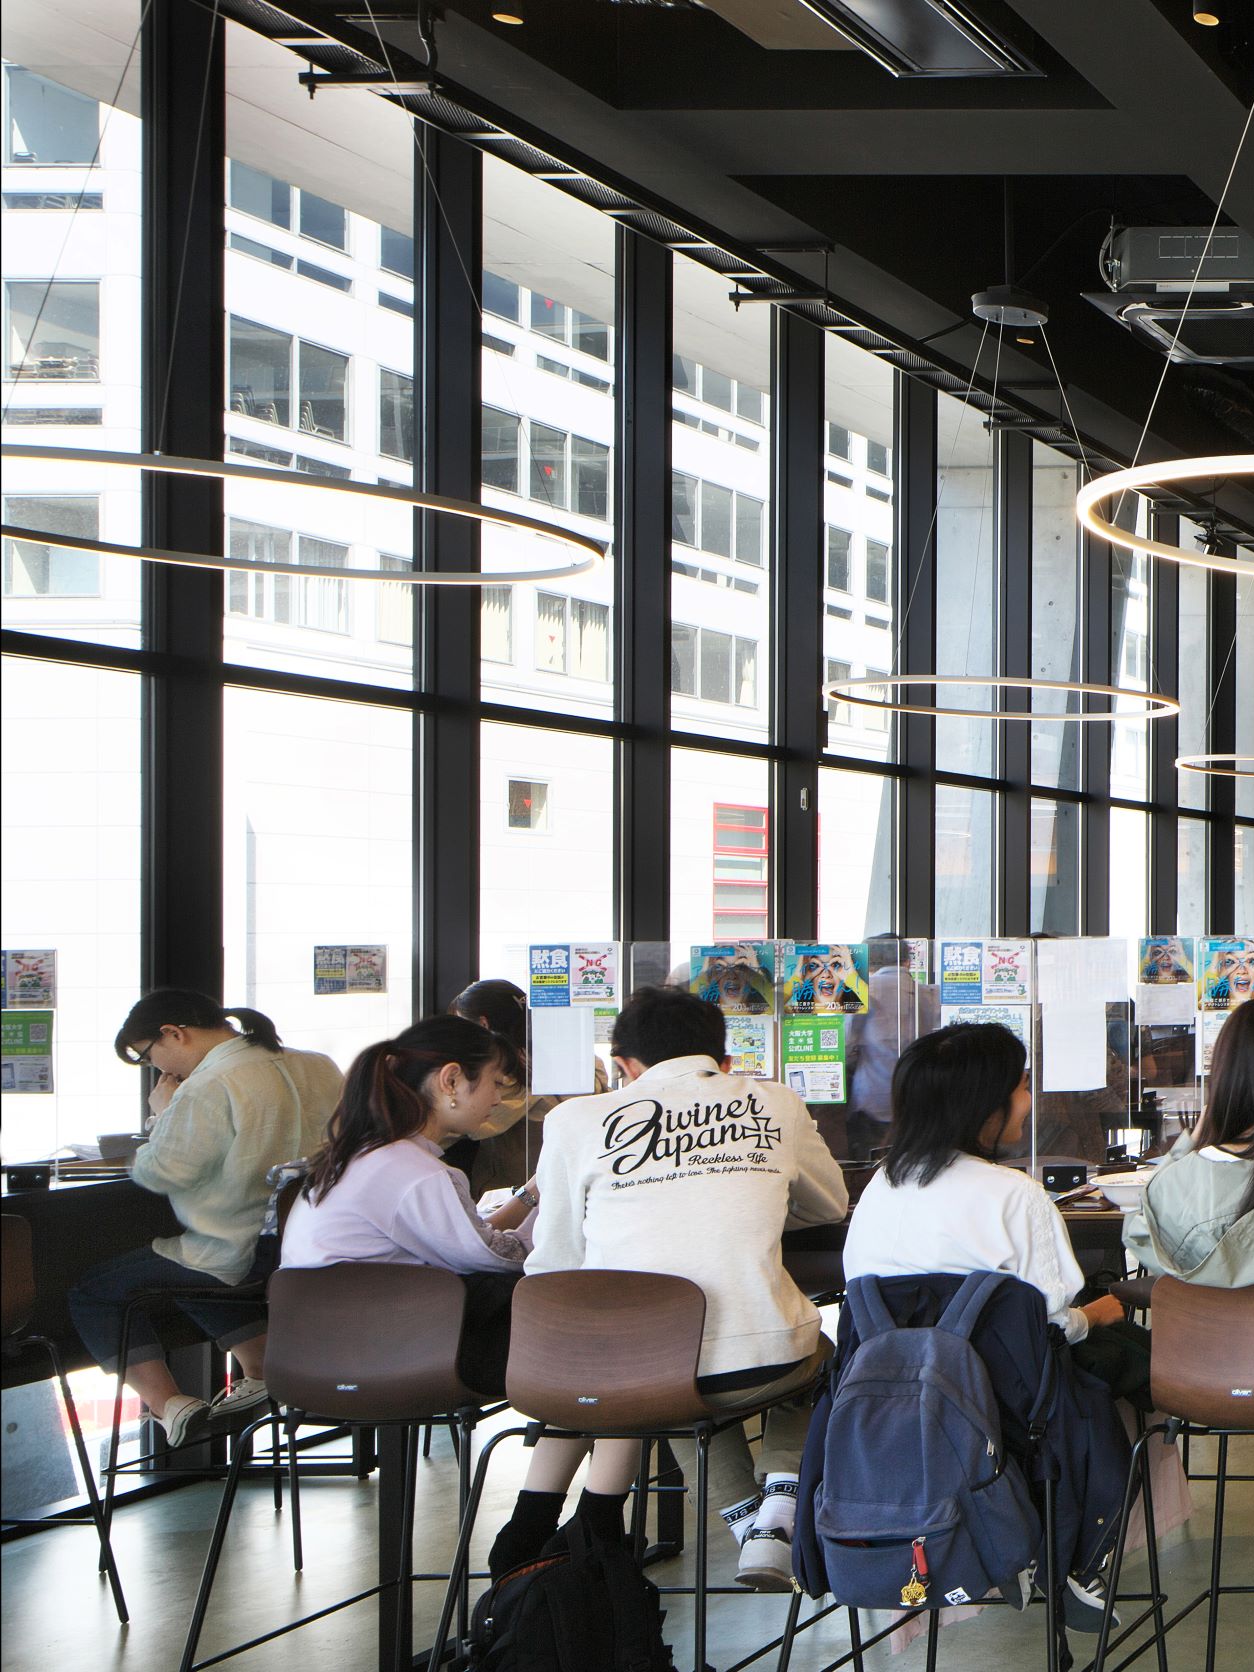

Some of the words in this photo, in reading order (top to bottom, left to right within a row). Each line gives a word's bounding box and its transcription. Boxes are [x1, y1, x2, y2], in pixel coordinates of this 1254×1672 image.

[532, 949, 568, 969] 黙食
[586, 959, 602, 967] NG
[943, 946, 981, 966] 黙食
[998, 957, 1015, 965] NG
[612, 1120, 744, 1176] Japan
[687, 1152, 743, 1166] Reckless
[636, 1176, 664, 1186] nothing
[706, 1166, 721, 1175] The
[721, 1166, 748, 1174] fighting
